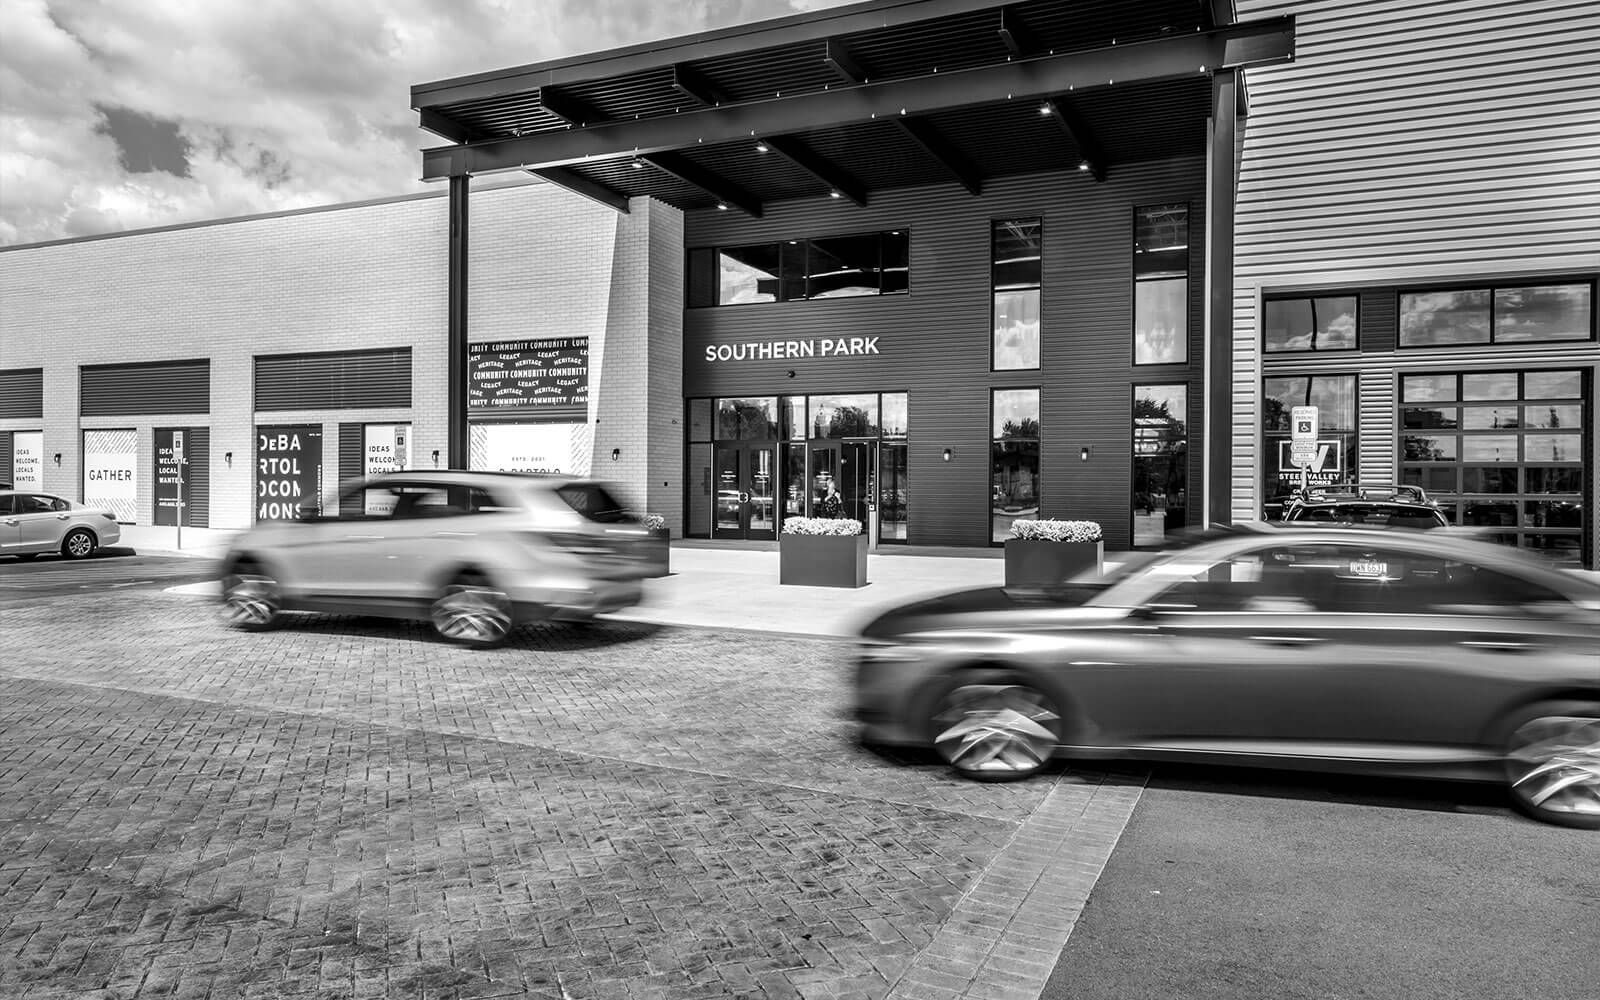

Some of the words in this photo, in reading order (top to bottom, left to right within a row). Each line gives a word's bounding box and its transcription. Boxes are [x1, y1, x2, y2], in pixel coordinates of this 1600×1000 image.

[492, 343, 528, 351] COMMUNITY
[530, 340, 567, 349] COMMUNITY
[706, 340, 814, 361] SOUTHERN
[821, 336, 879, 356] PARK
[537, 350, 560, 358] LEGACY
[478, 361, 504, 369] HERITAGE
[515, 359, 542, 367] HERITAGE
[553, 357, 582, 366] HERITAGE
[473, 370, 509, 380] COMMUNITY
[510, 369, 547, 378] COMMUNITY
[549, 367, 587, 377] COMMUNITY
[556, 378, 579, 386] LEGACY
[496, 387, 523, 396] HERITAGE
[534, 386, 562, 395] HERITAGE
[491, 397, 528, 405] COMMUNITY
[529, 396, 567, 404] COMMUNITY
[89, 469, 132, 481] GATHER
